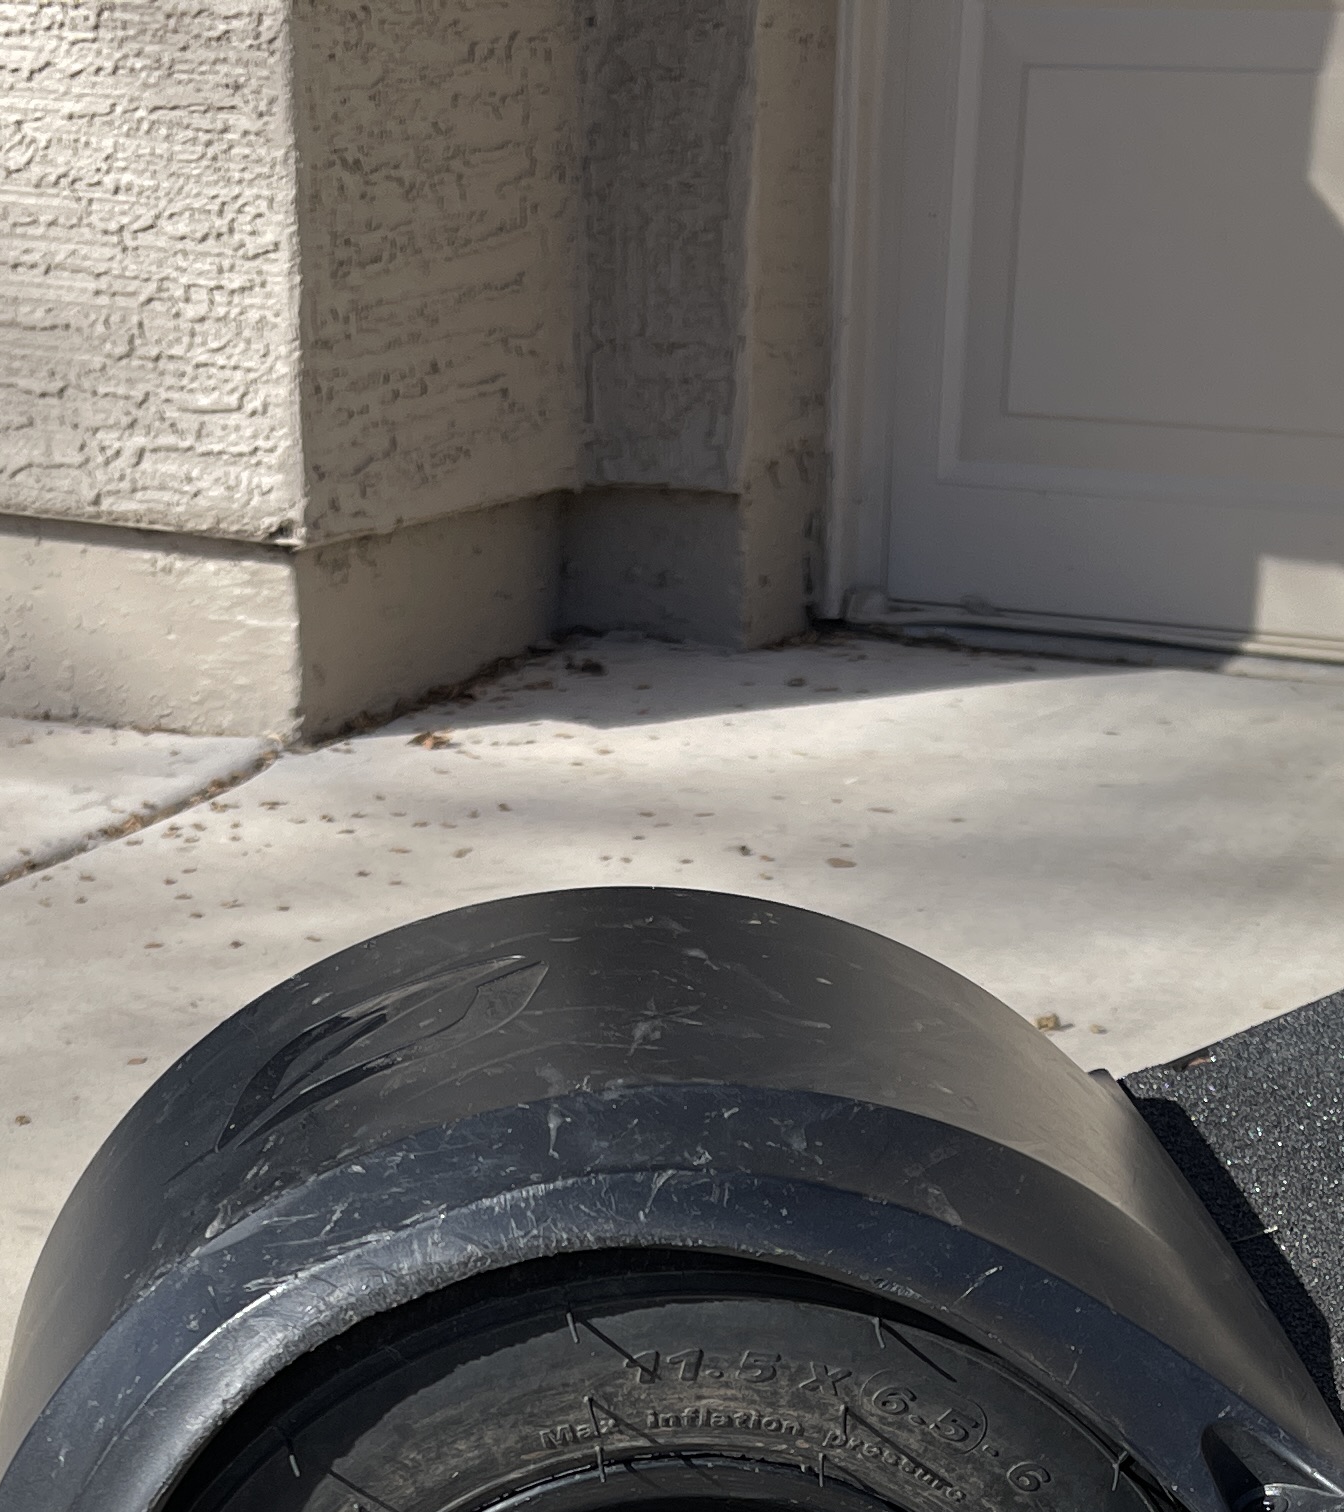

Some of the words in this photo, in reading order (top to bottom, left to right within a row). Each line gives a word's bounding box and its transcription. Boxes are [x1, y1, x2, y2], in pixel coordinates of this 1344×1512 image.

[623, 1348, 782, 1386] 11.5
[538, 1417, 617, 1449] Max
[645, 1406, 806, 1437] inflation
[823, 1429, 967, 1503] pressure
